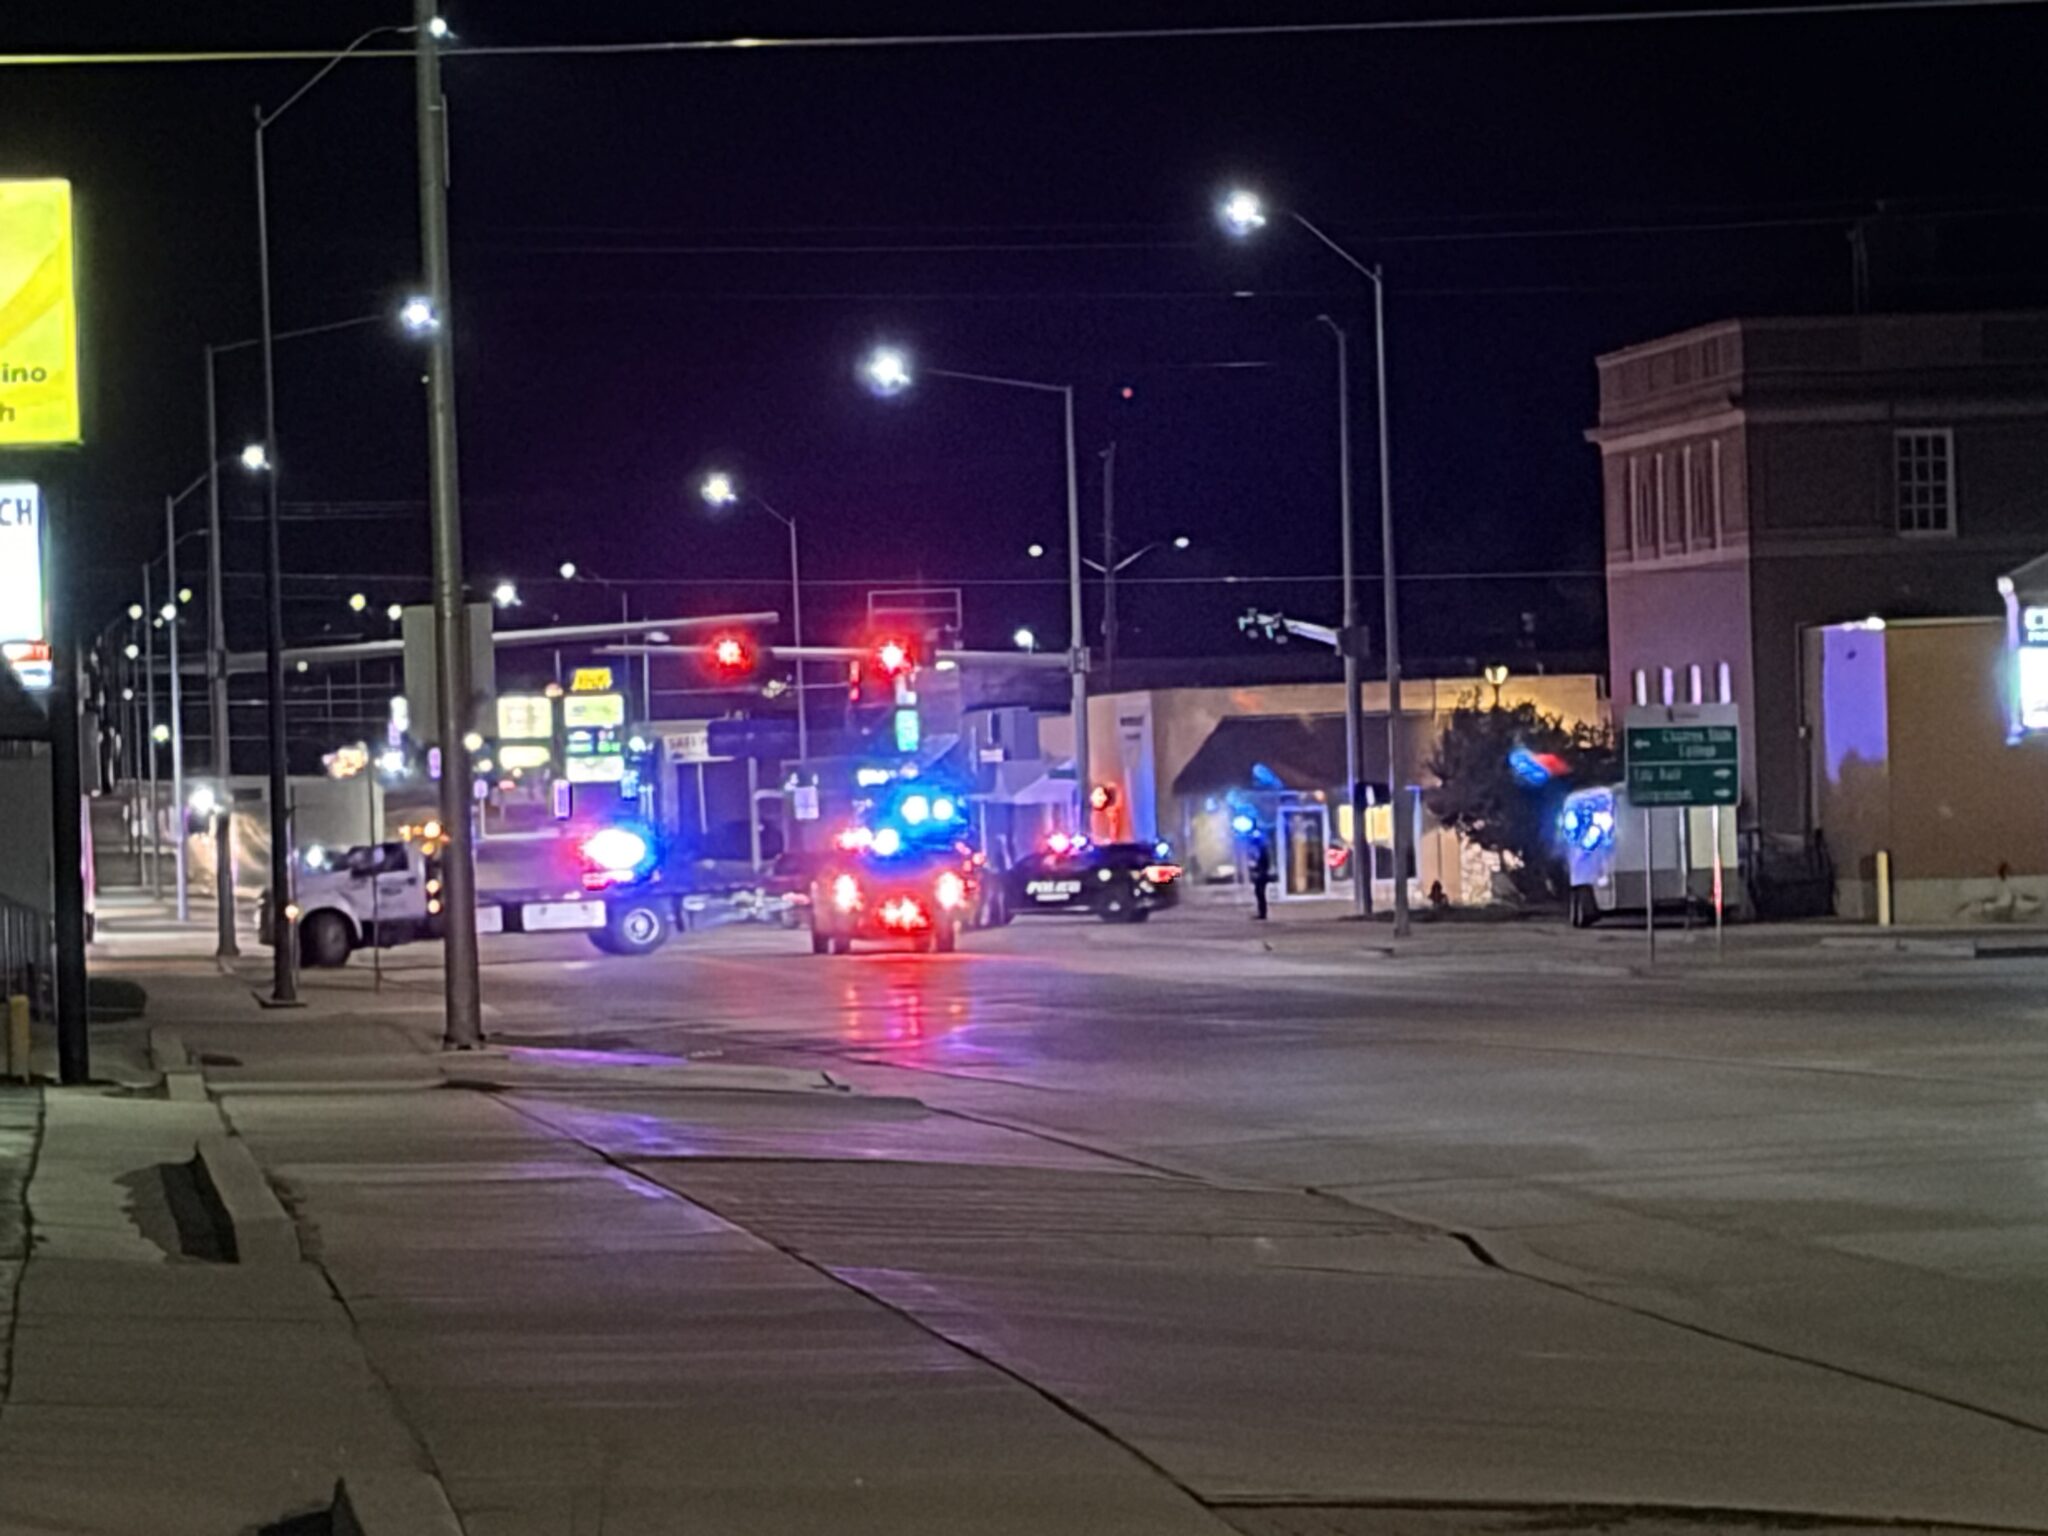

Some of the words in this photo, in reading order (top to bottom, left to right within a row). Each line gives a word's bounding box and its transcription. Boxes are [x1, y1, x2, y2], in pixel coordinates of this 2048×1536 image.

[2, 362, 47, 383] ino
[0, 497, 32, 526] CH
[1026, 880, 1082, 895] POLICE
